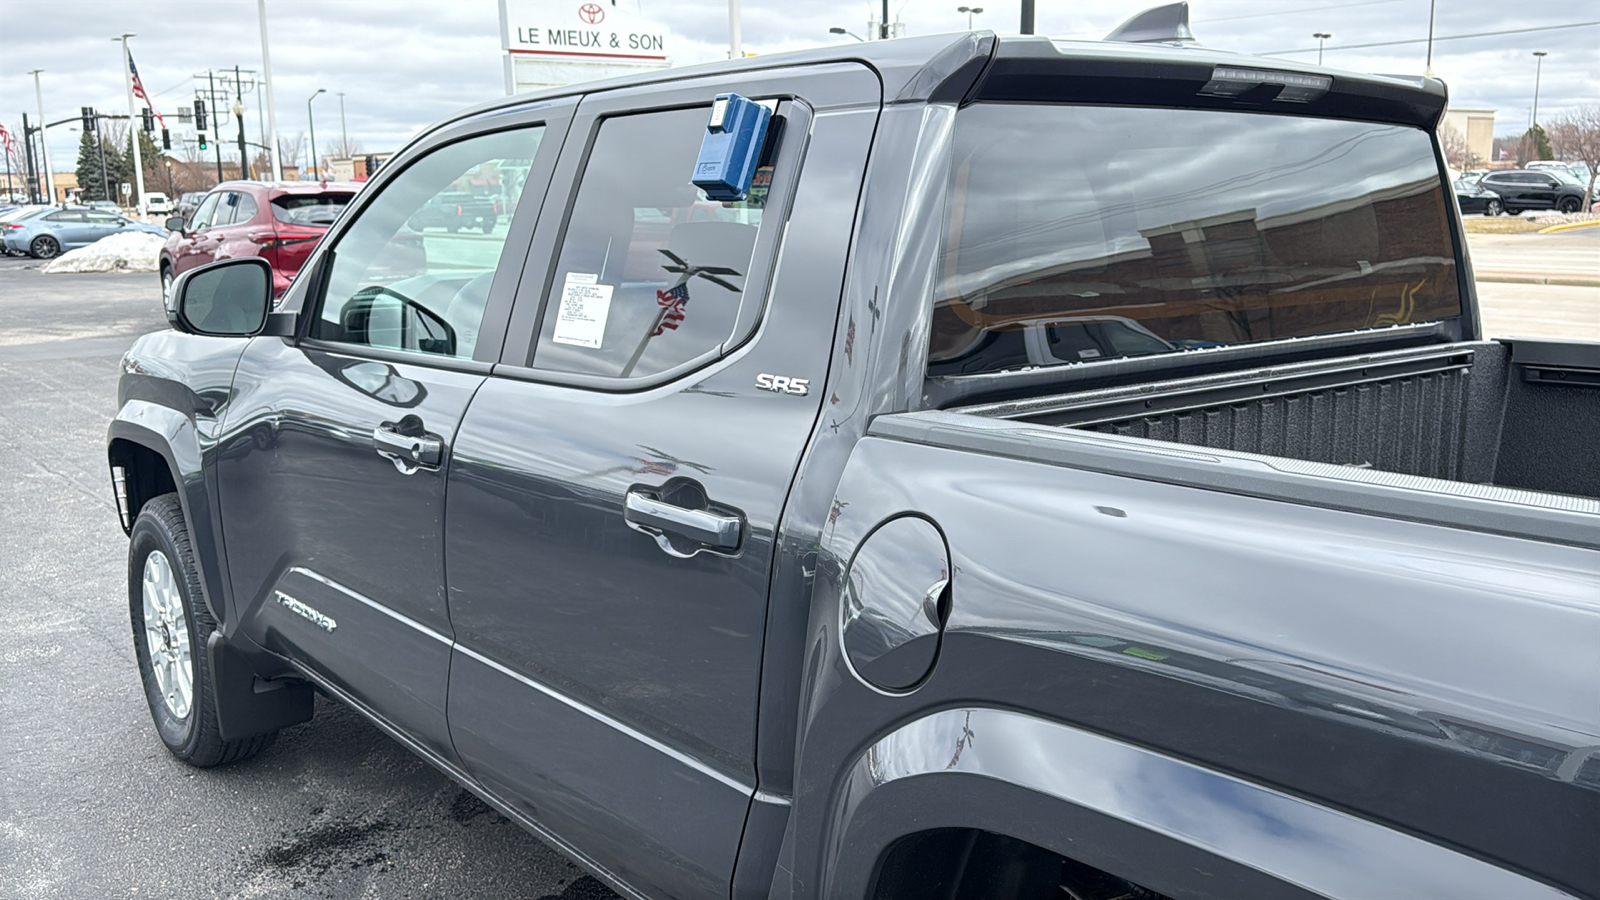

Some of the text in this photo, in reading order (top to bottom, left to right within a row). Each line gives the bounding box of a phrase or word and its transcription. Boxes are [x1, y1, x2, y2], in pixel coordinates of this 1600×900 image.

[518, 27, 663, 50] LE MIEUX & SON
[755, 373, 810, 396] SR5
[275, 590, 337, 632] TACOMA
